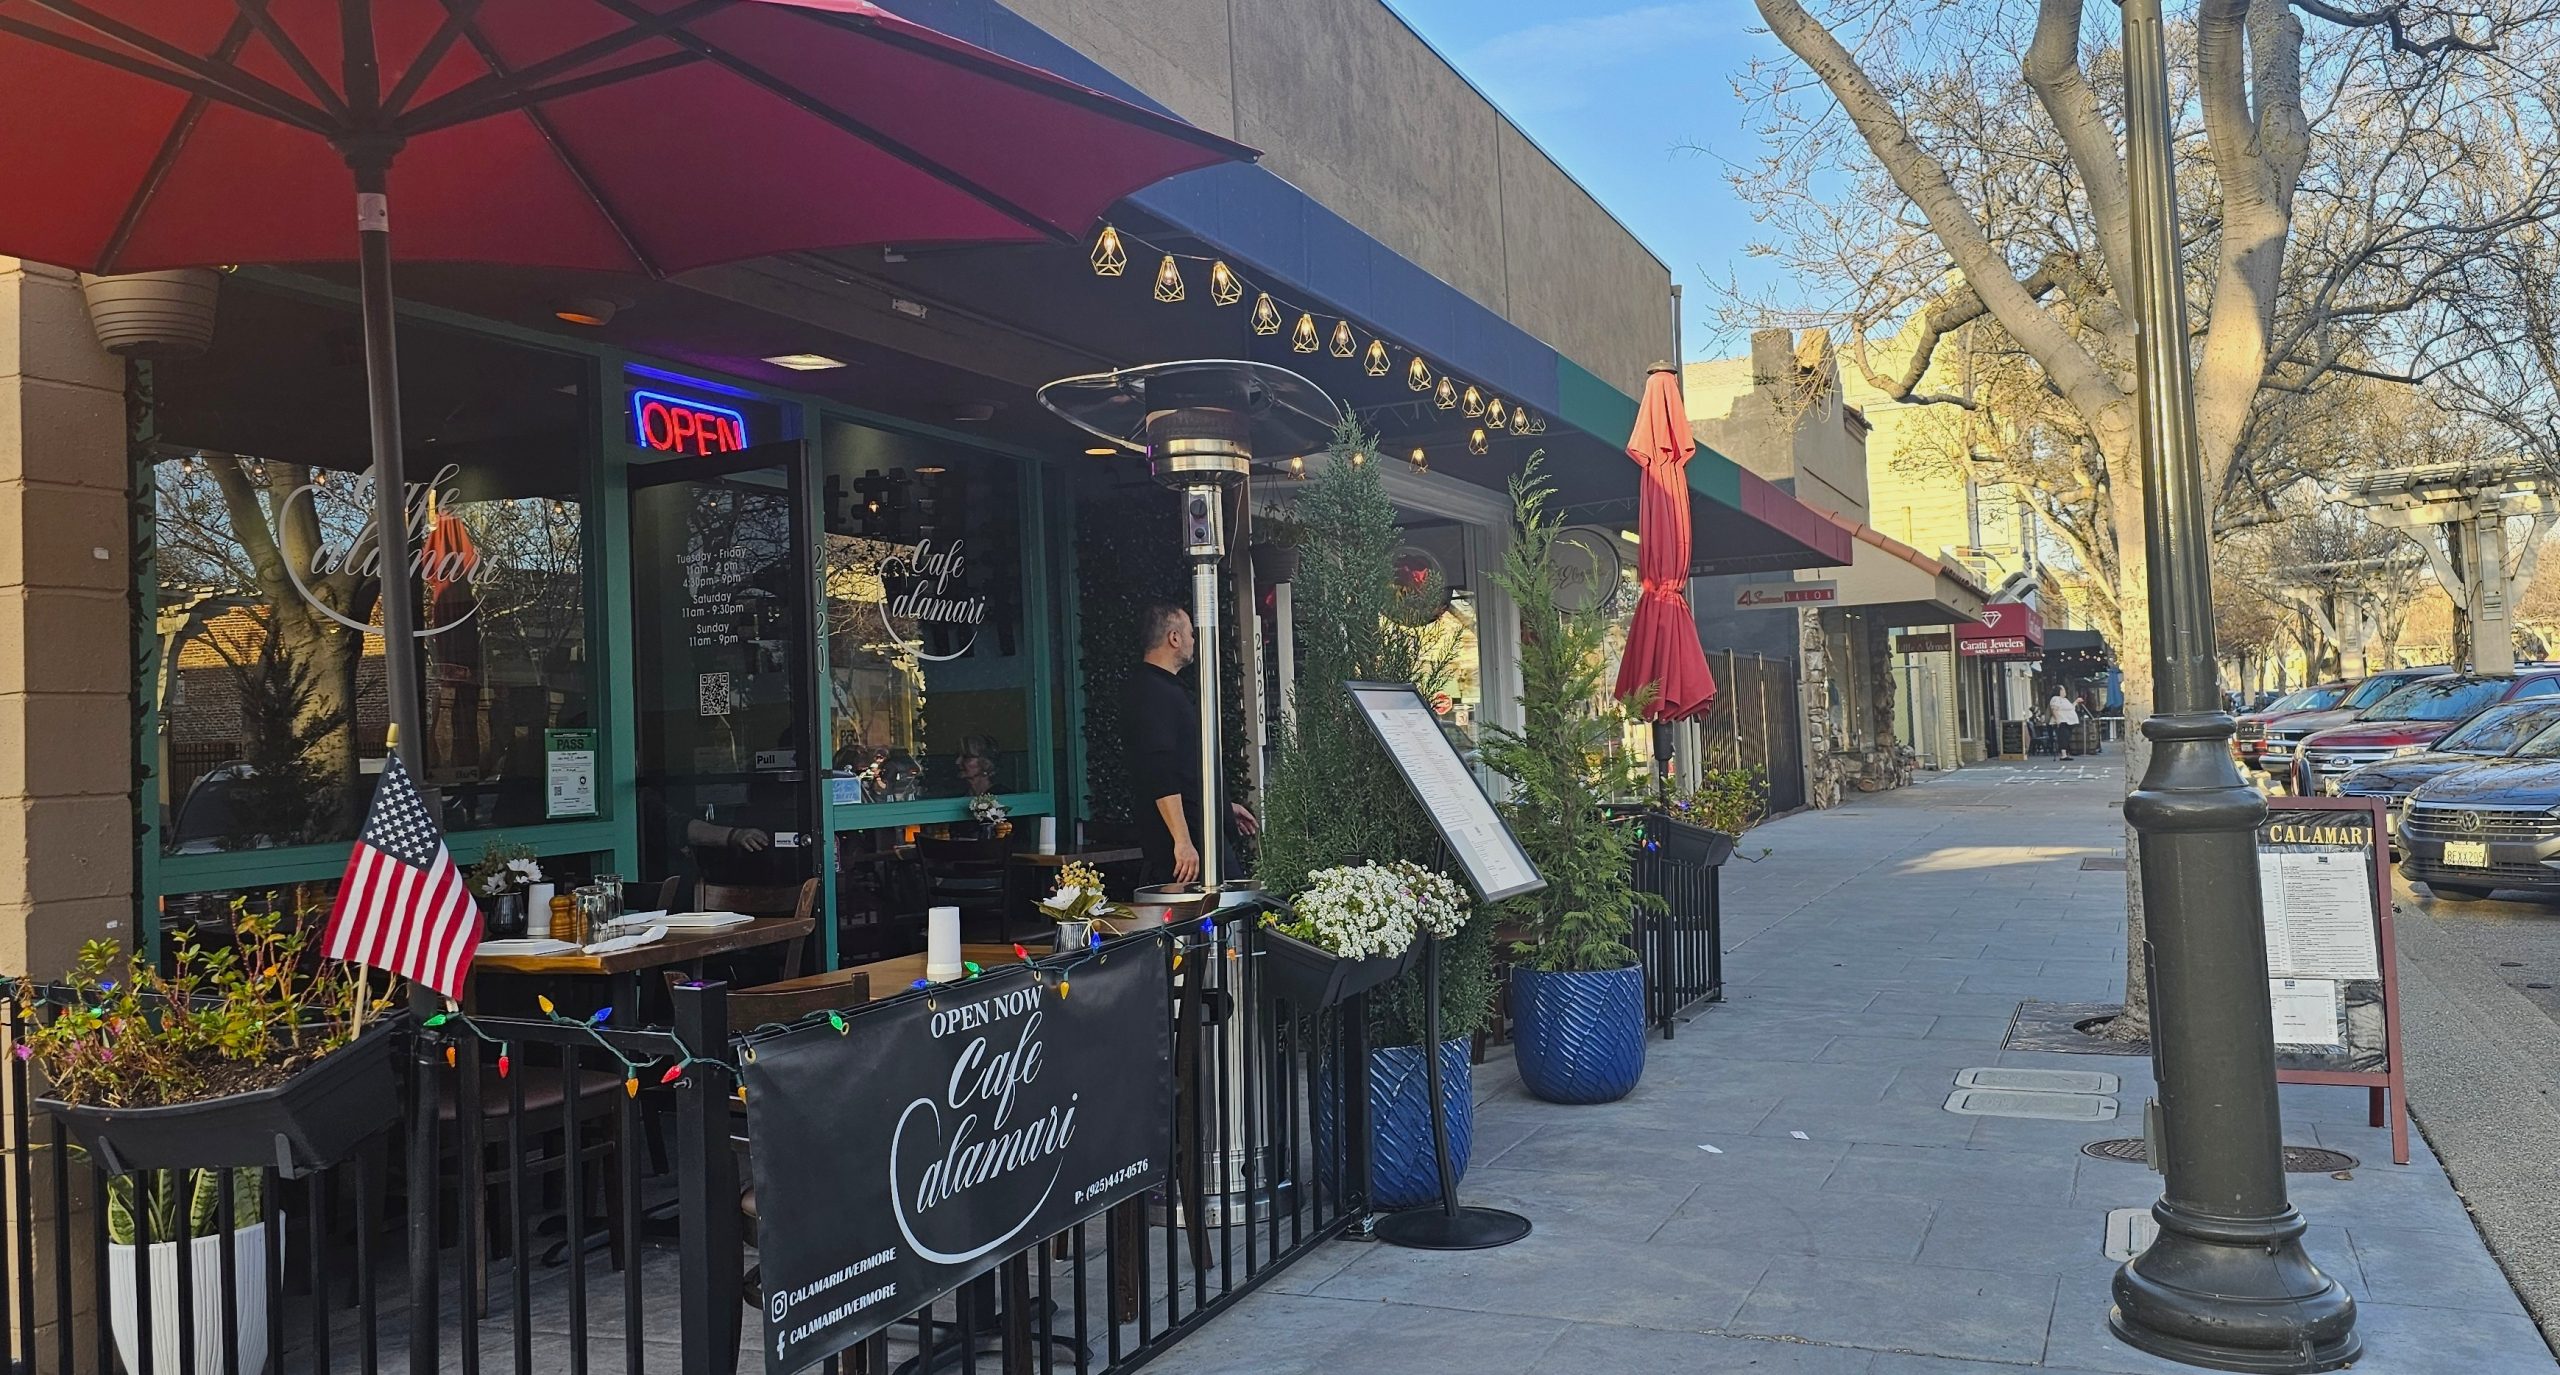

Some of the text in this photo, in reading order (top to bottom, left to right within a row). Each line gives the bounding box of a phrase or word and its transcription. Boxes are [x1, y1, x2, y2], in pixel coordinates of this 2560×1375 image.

[643, 402, 742, 456] OPEN
[676, 551, 712, 564] Tuesday
[719, 547, 747, 559] Friday
[686, 565, 709, 576] 11am
[911, 538, 965, 596] Cafe
[683, 576, 714, 589] 4:30pm
[721, 573, 741, 585] 9pm
[692, 591, 732, 605] Saturday
[682, 607, 705, 618] 11am
[712, 603, 744, 616] 9:30pm
[815, 544, 826, 674] 2020
[878, 555, 986, 662] Calamari
[689, 636, 711, 647] 11am
[719, 633, 738, 645] 9pm
[696, 622, 730, 635] Sunday
[1960, 640, 1987, 651] Caratti
[1990, 638, 2025, 649] Jewelers
[1255, 633, 1264, 724] 2026
[557, 738, 584, 750] PASS
[757, 755, 775, 765] Pull
[2269, 825, 2374, 846] CALAMARI
[930, 984, 1044, 1040] OPEN NOW
[948, 1010, 1043, 1131] Cafe
[890, 1092, 1078, 1265] Calamari
[1074, 1158, 1149, 1205] P: (925)447-0576
[789, 1246, 897, 1307] CALAMARILIVERMORE
[789, 1281, 897, 1345] CALAMARILIVERMORE
